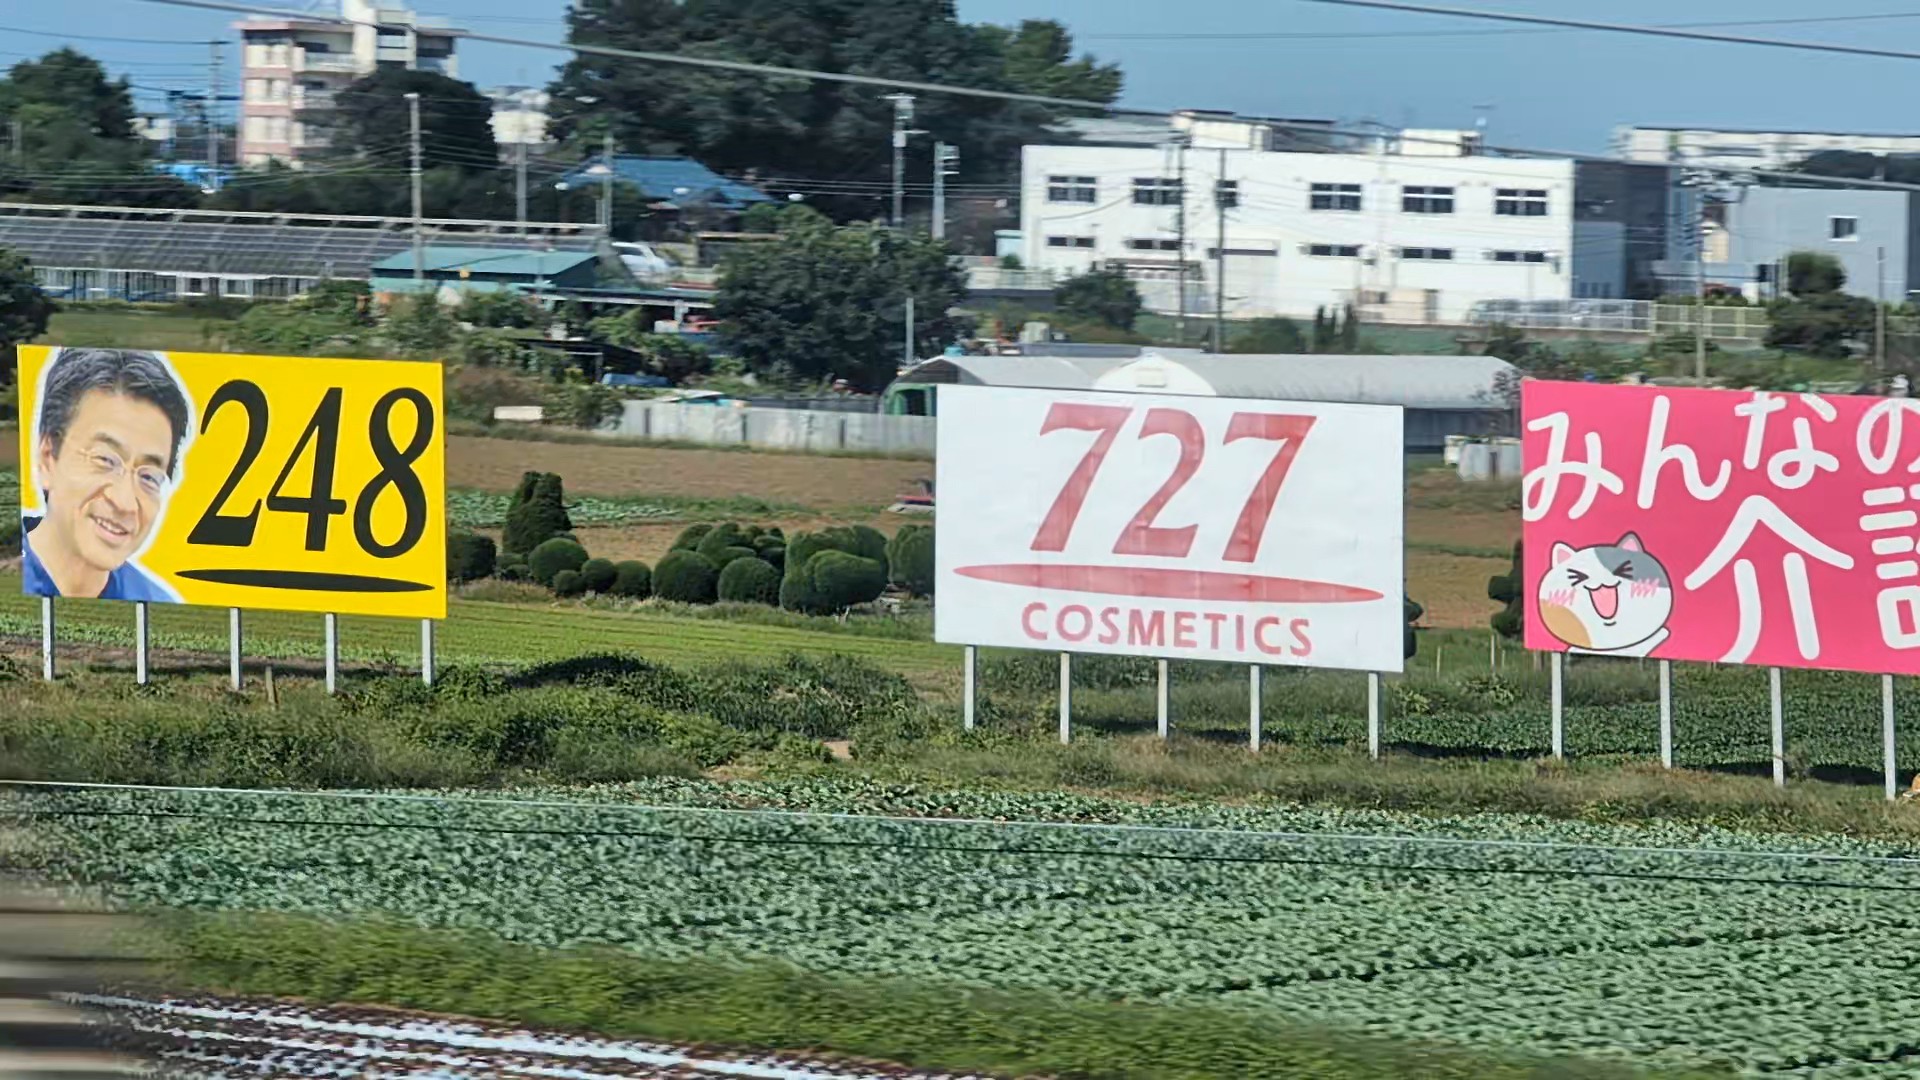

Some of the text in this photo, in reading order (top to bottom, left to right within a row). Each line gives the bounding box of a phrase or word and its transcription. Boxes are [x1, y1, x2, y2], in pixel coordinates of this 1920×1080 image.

[187, 379, 435, 559] 248
[1029, 402, 1318, 563] 727
[1522, 391, 1920, 522] みんなの
[1021, 602, 1313, 657] COSMETICS
